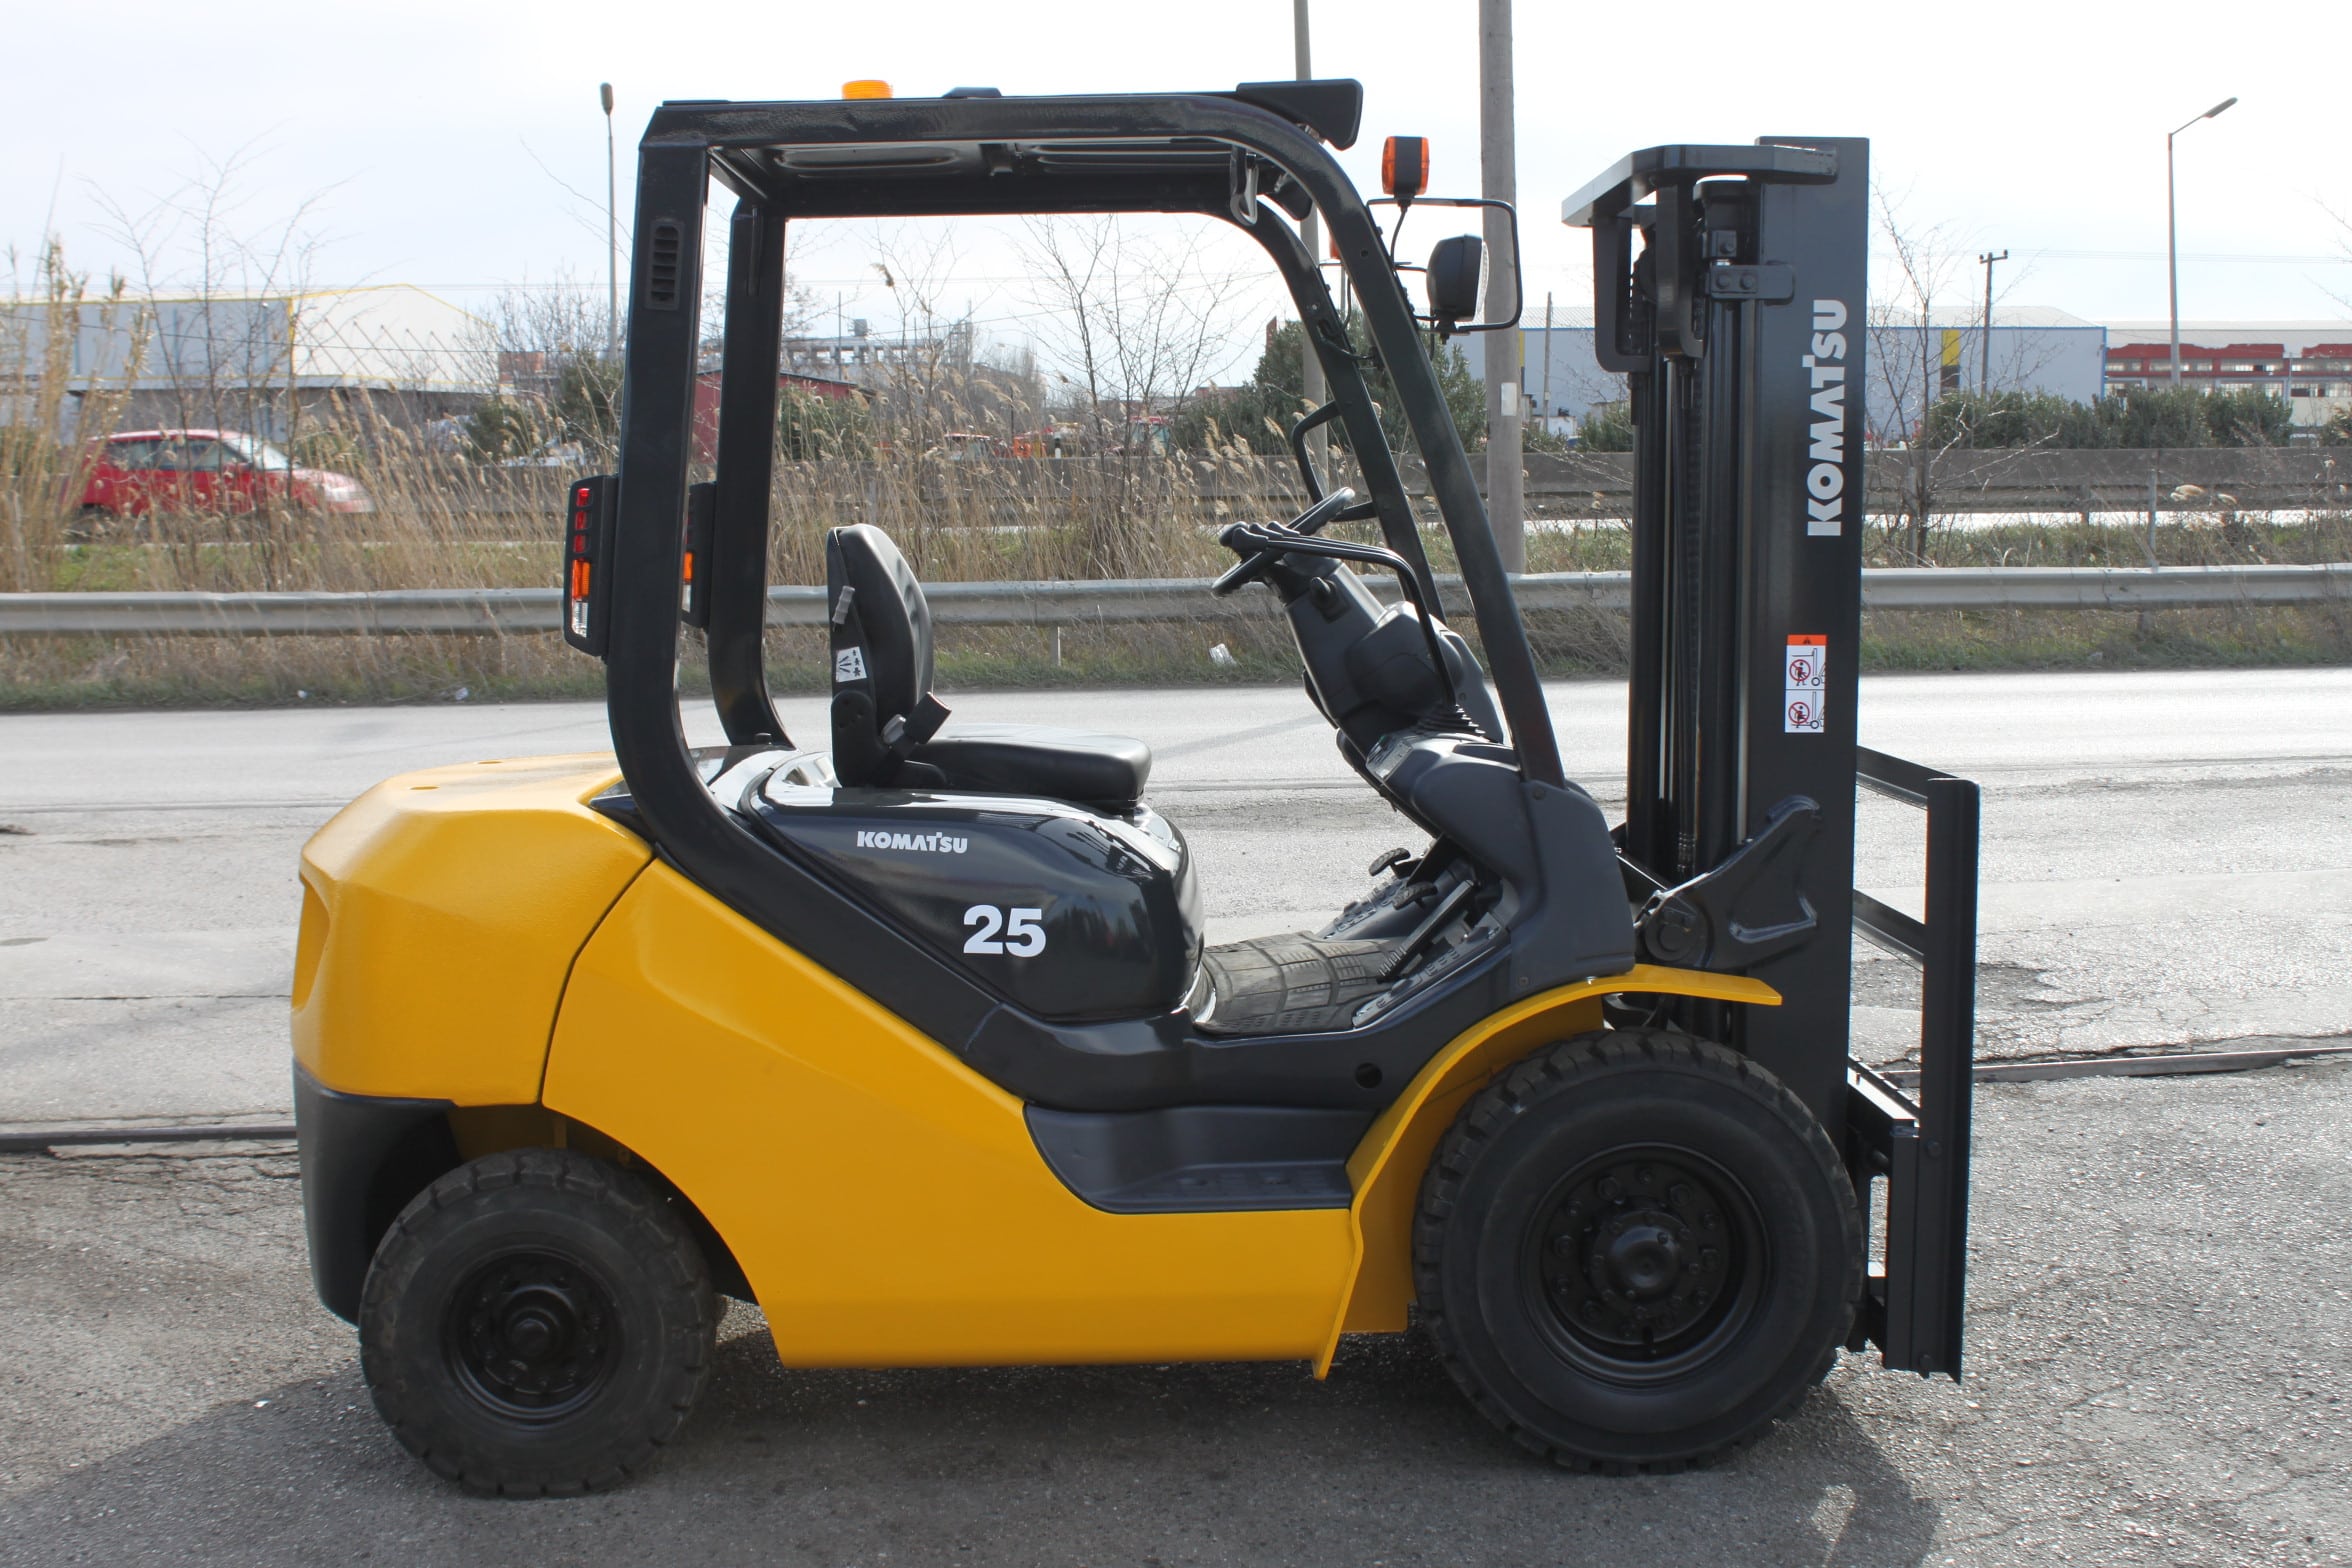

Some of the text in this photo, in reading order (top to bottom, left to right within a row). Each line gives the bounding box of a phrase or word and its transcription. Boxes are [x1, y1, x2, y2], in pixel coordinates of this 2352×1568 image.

[1802, 300, 1847, 536] KOMATSU
[857, 831, 968, 853] KOMATSU
[963, 905, 1046, 958] 25
